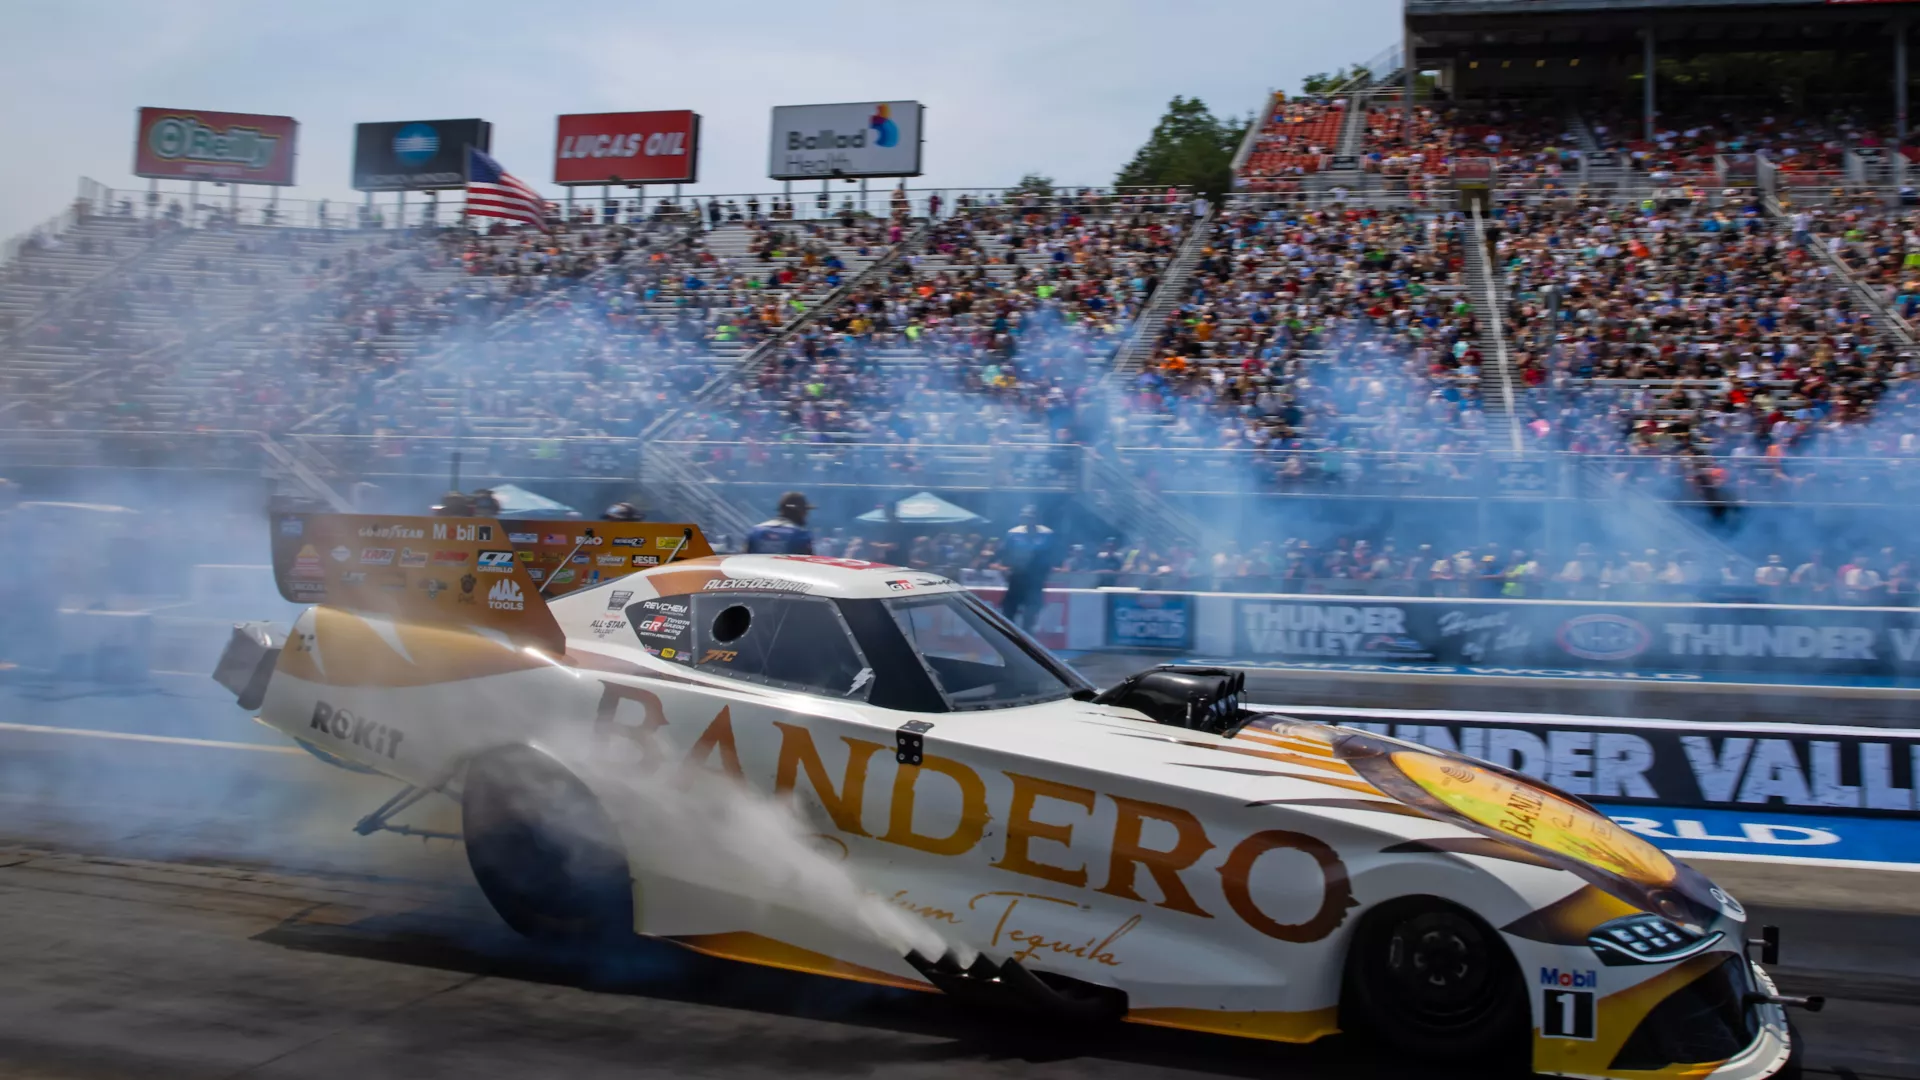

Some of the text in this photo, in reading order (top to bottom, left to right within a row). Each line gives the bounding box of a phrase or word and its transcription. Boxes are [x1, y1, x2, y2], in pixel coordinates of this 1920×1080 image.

[560, 132, 686, 159] LUCAS OIL
[787, 129, 865, 151] Ballad
[433, 524, 475, 541] Mobil
[477, 565, 513, 573] CARRILLO
[633, 555, 659, 565] JESEL
[488, 578, 524, 601] MAC
[703, 578, 750, 591] ALEXIS
[489, 601, 524, 611] TOOLS
[643, 601, 688, 614] REVCHEM
[640, 620, 662, 631] GR
[663, 622, 685, 630] GAZOO
[667, 617, 690, 626] TOYOTA
[1242, 604, 1407, 634] THUNDER
[1248, 629, 1363, 657] VALLEY
[1661, 623, 1878, 660] THUNDER
[1468, 667, 1702, 680] WORLD
[1679, 735, 1920, 811] VALL
[597, 679, 1358, 944] BANDERO
[1607, 815, 1842, 846] RLD
[969, 890, 1142, 967] Tequila
[1539, 967, 1597, 988] Mobil
[1556, 992, 1577, 1035] 1
